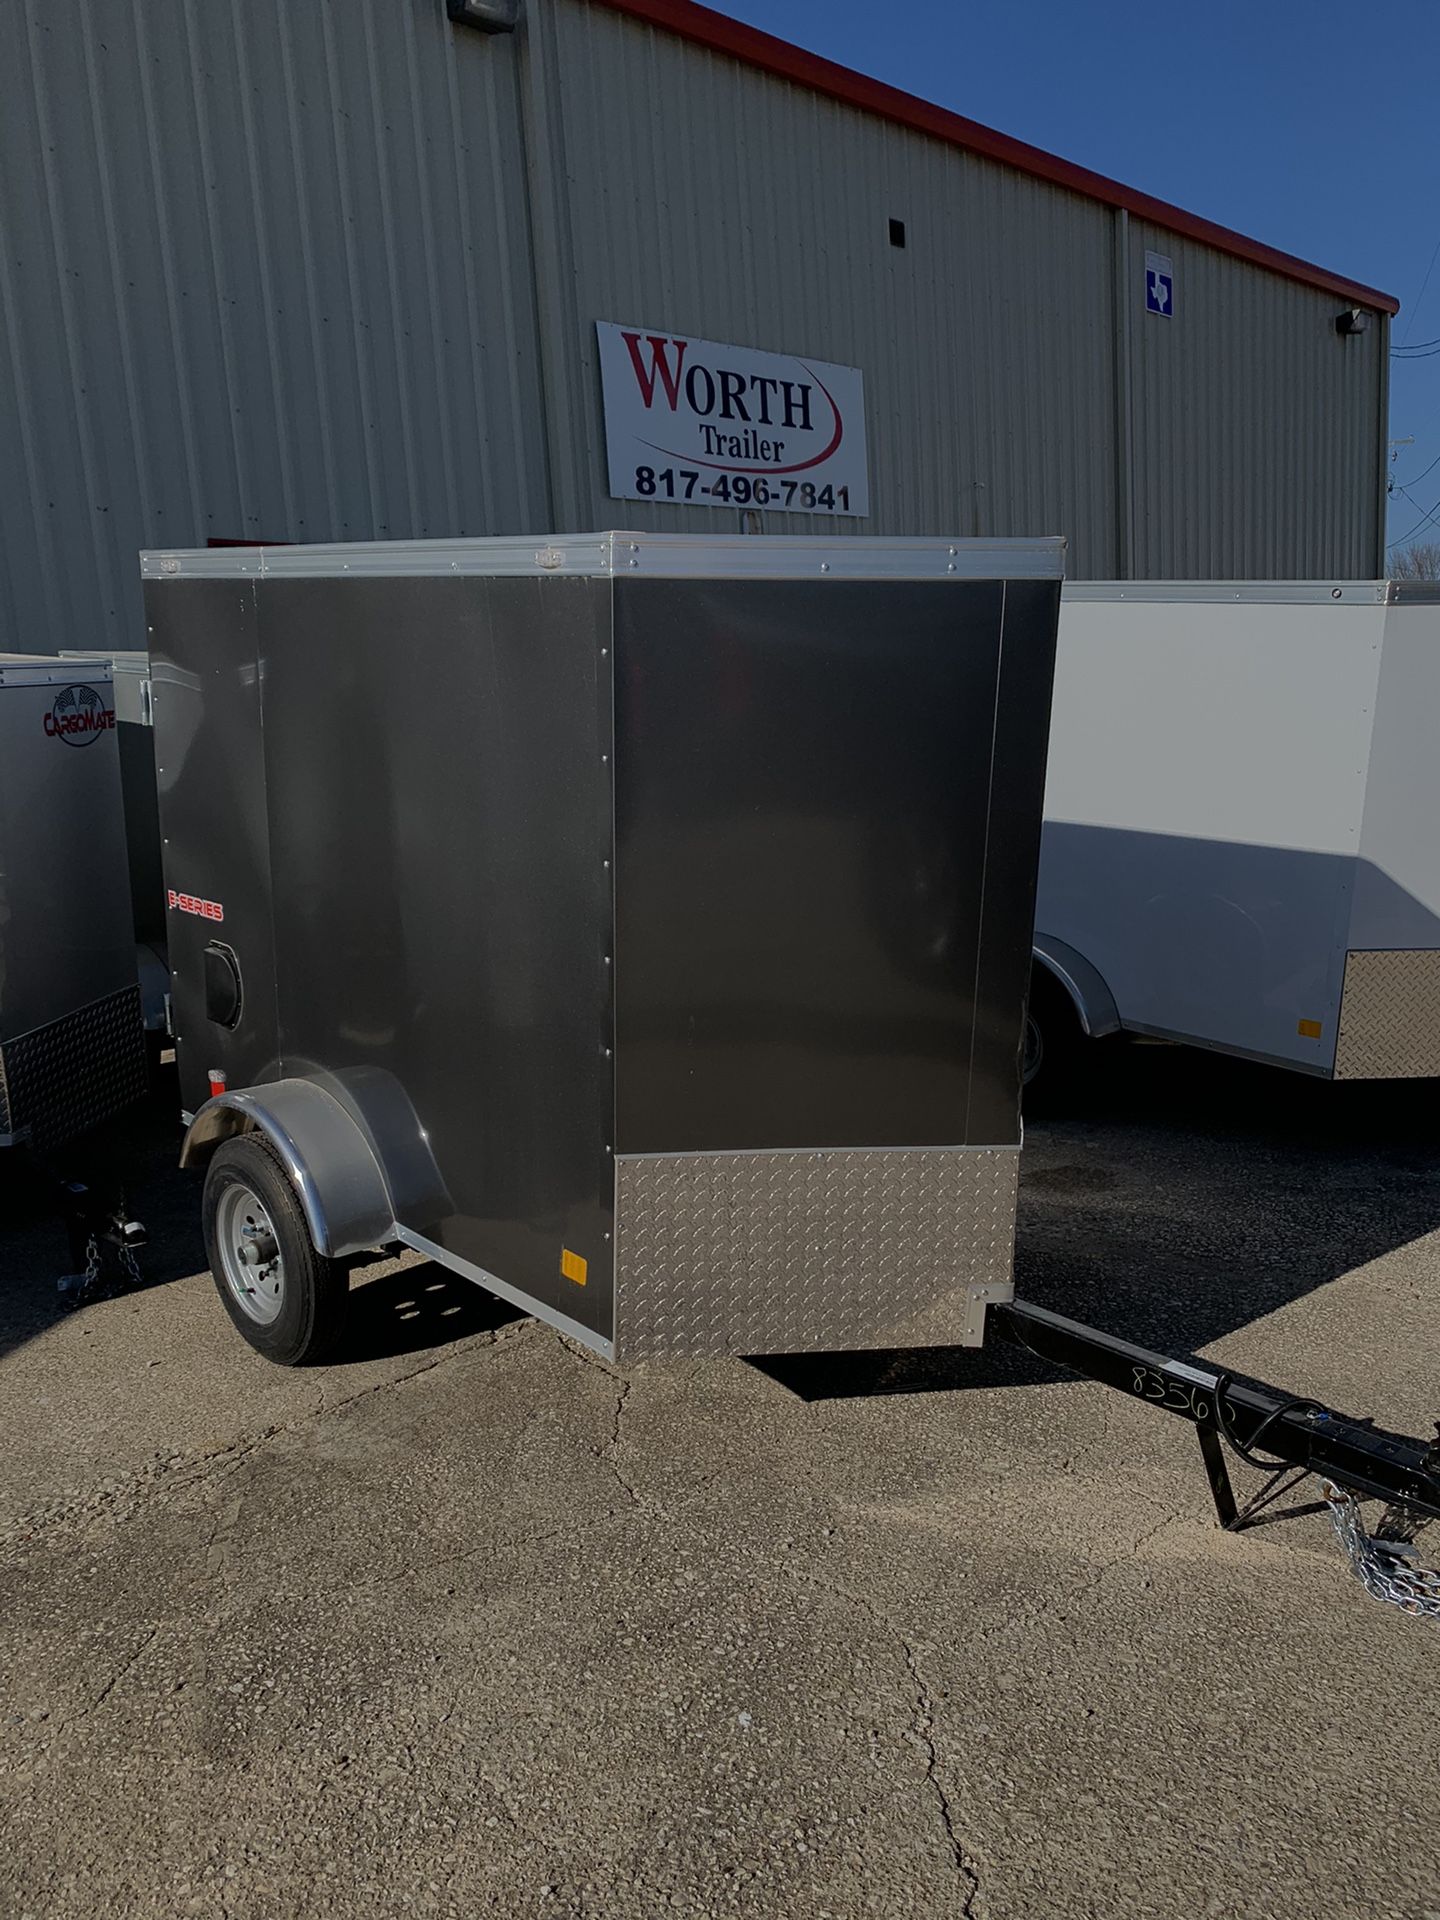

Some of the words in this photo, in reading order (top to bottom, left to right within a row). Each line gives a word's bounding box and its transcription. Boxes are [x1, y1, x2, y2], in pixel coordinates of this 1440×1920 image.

[621, 332, 814, 431] WORTH
[699, 424, 785, 463] Trailer
[635, 466, 850, 511] 817-496-7841
